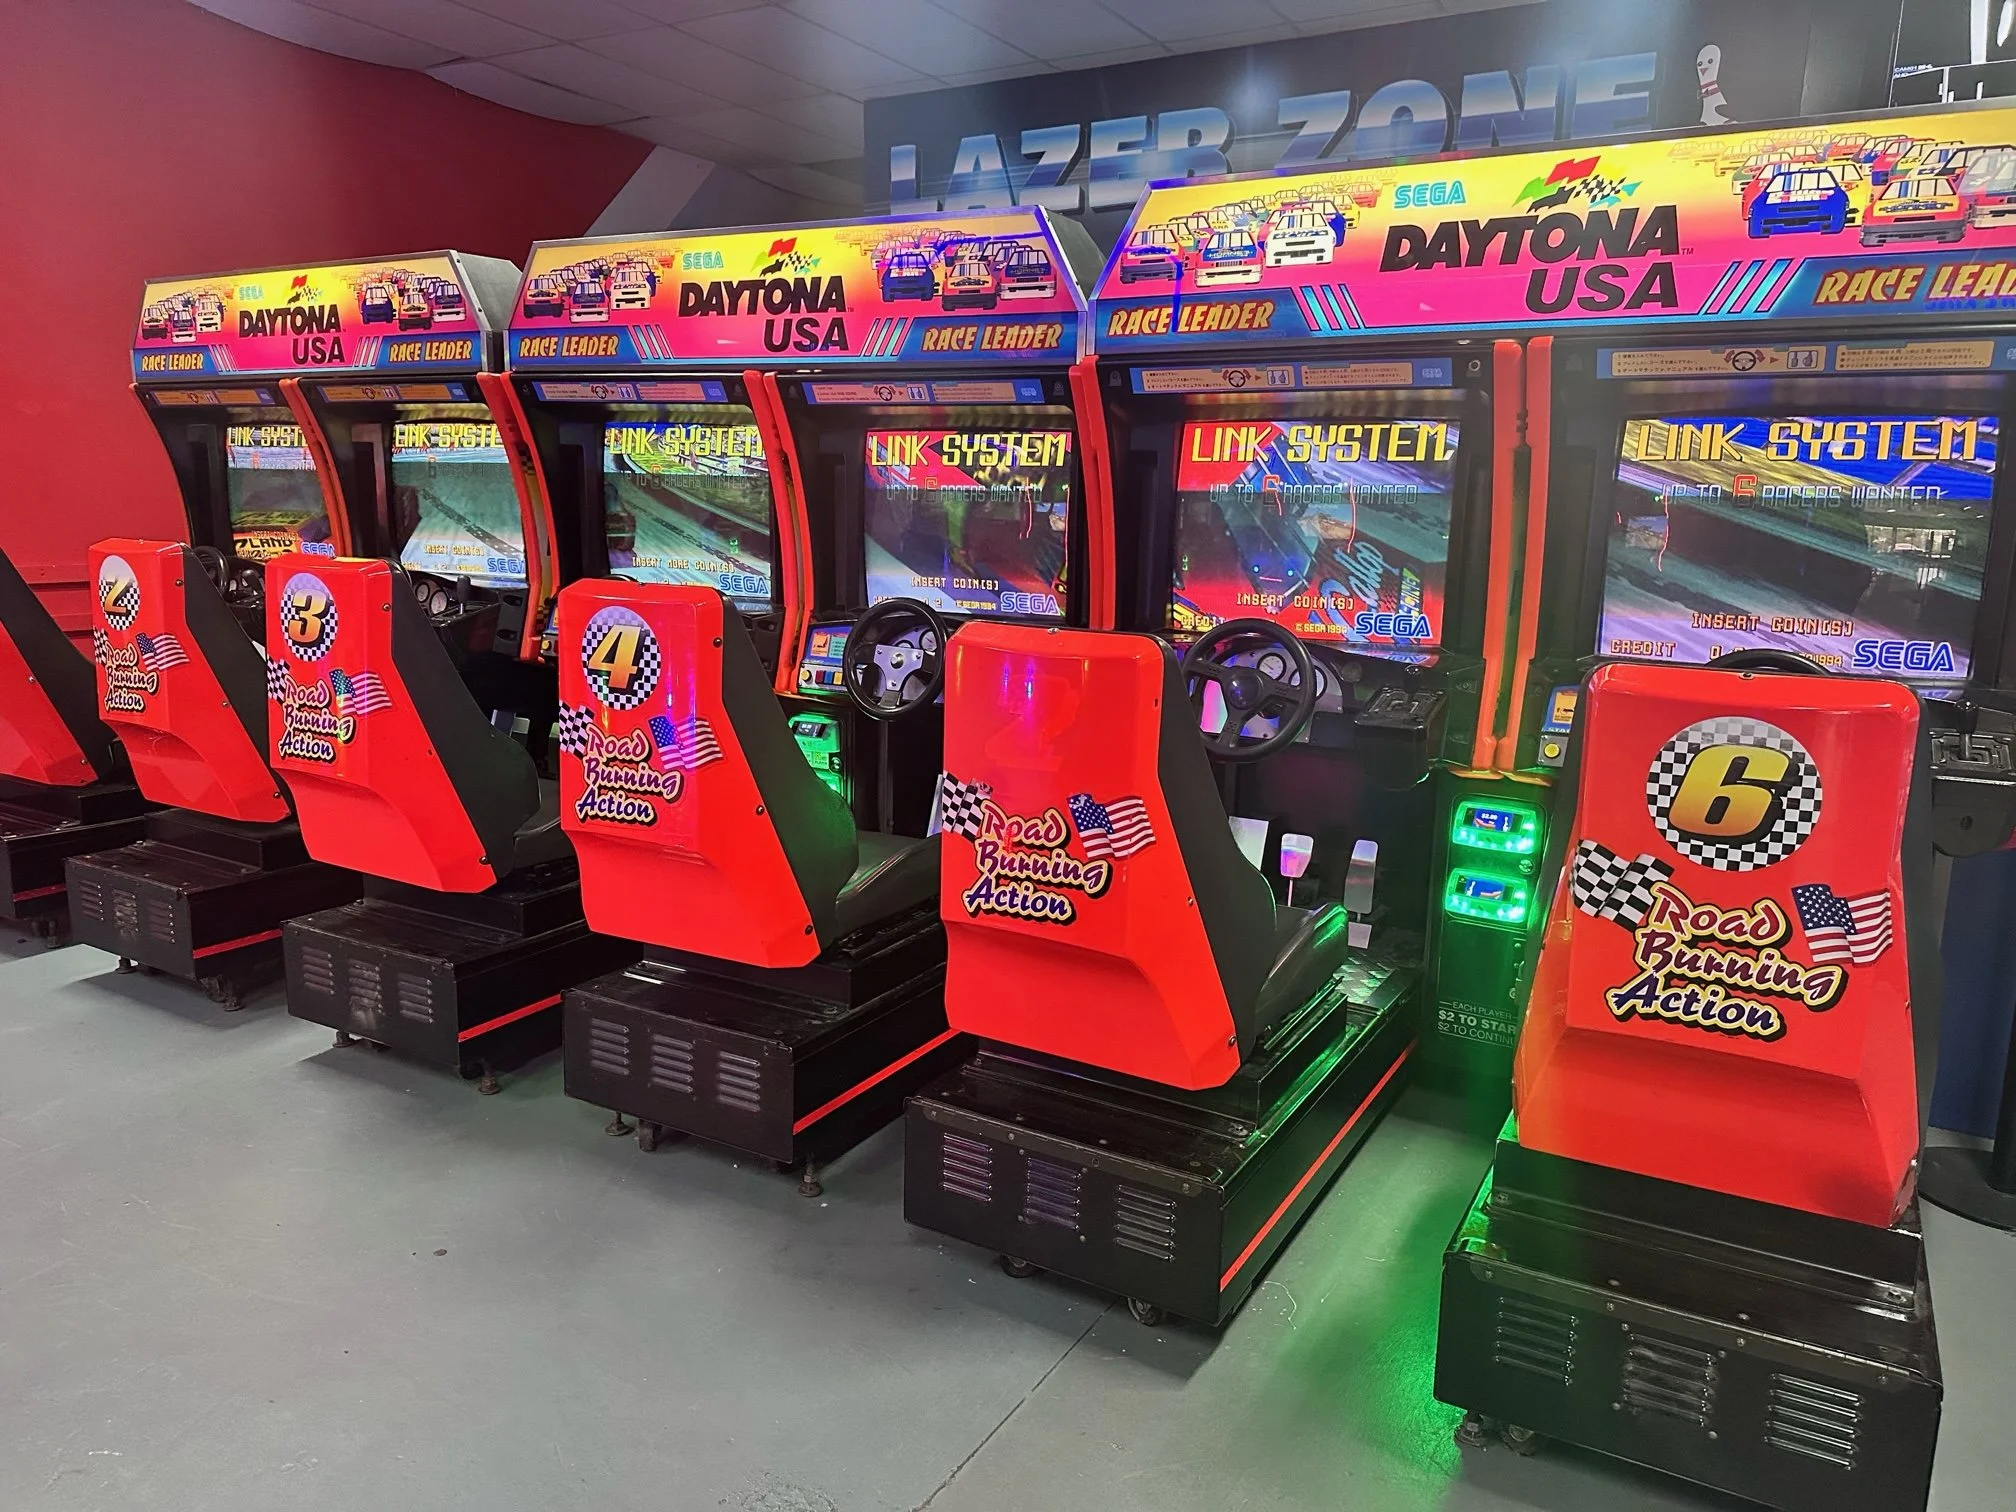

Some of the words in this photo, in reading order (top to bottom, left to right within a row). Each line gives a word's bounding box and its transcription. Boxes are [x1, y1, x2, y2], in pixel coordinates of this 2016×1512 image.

[890, 107, 1230, 214] LAZER
[1275, 52, 1657, 169] ZONE
[1394, 180, 1466, 209] SEGA
[1379, 205, 1680, 272] DAYTONA
[682, 251, 724, 270] SEGA
[678, 277, 848, 317] DAYTONA
[1525, 262, 1679, 314] USA
[1815, 267, 1925, 304] RACE
[239, 304, 341, 338] DAYTONA
[1108, 307, 1173, 336] RACE
[1177, 301, 1275, 332] LEADER
[292, 336, 345, 365] USA
[389, 343, 421, 362] RACE
[424, 340, 472, 360] LEADER
[519, 337, 558, 357] RACE
[561, 335, 619, 356] LEADER
[763, 318, 849, 353] USA
[923, 326, 977, 351] RACE
[981, 323, 1063, 350] LEADER
[142, 355, 166, 371] RACE
[169, 353, 203, 370] LEADER
[227, 427, 255, 446] LINK
[395, 425, 431, 447] LINK
[609, 427, 655, 455] LINK
[665, 427, 764, 457] SYSTEM
[871, 435, 929, 466] LINK
[942, 433, 1066, 467] SYSTEM
[1191, 426, 1271, 462] LINK
[1288, 424, 1450, 462] SYSTEM
[1637, 423, 1744, 462] LINK
[1766, 421, 1978, 462] SYSTEM
[887, 485, 901, 500] UP
[906, 485, 918, 500] TO
[940, 485, 985, 501] RACERS
[991, 485, 1042, 501] WANTED
[1209, 484, 1228, 502] UP
[1235, 484, 1253, 502] TO
[1262, 475, 1280, 507] 6
[1284, 484, 1342, 503] RACERS
[1352, 484, 1418, 504] WANTED
[1662, 484, 1687, 505] UP
[1696, 484, 1722, 505] TO
[1732, 474, 1757, 509] 6
[1761, 485, 1842, 508] RACERS
[1851, 485, 1941, 508] WANTED
[632, 557, 662, 567] INSERT
[668, 559, 689, 568] MORE
[103, 576, 132, 614] 2
[719, 574, 769, 594] SEGA
[910, 577, 947, 588] INSERT
[288, 588, 327, 643] 3
[1001, 592, 1060, 615] SEGA
[1236, 593, 1284, 607] INSERT
[1355, 611, 1432, 638] SEGA
[1692, 613, 1759, 632] INSERT
[105, 643, 137, 665] Road
[588, 625, 641, 689] 4
[1610, 639, 1676, 658] CREDIT
[1853, 640, 1954, 672] SEGA
[106, 667, 157, 691] Burning
[284, 676, 329, 707] Road
[105, 688, 143, 711] Action
[283, 707, 353, 740] Burning
[279, 729, 333, 759] Action
[587, 725, 647, 759] Road
[584, 757, 680, 798] Burning
[1669, 744, 1790, 838] 6
[577, 786, 653, 821] Action
[983, 802, 1066, 846] Road
[976, 838, 1108, 892] Burning
[963, 875, 1072, 919] Action
[1652, 882, 1785, 943] Road
[1638, 930, 1842, 1007] Burning
[1439, 1010, 1455, 1021] $2
[1458, 1014, 1477, 1026] TO
[1453, 1001, 1477, 1012] EACH
[1478, 1007, 1512, 1020] PLAYER
[1608, 972, 1779, 1035] Action
[1437, 1021, 1450, 1031] $2
[1453, 1024, 1467, 1035] TO
